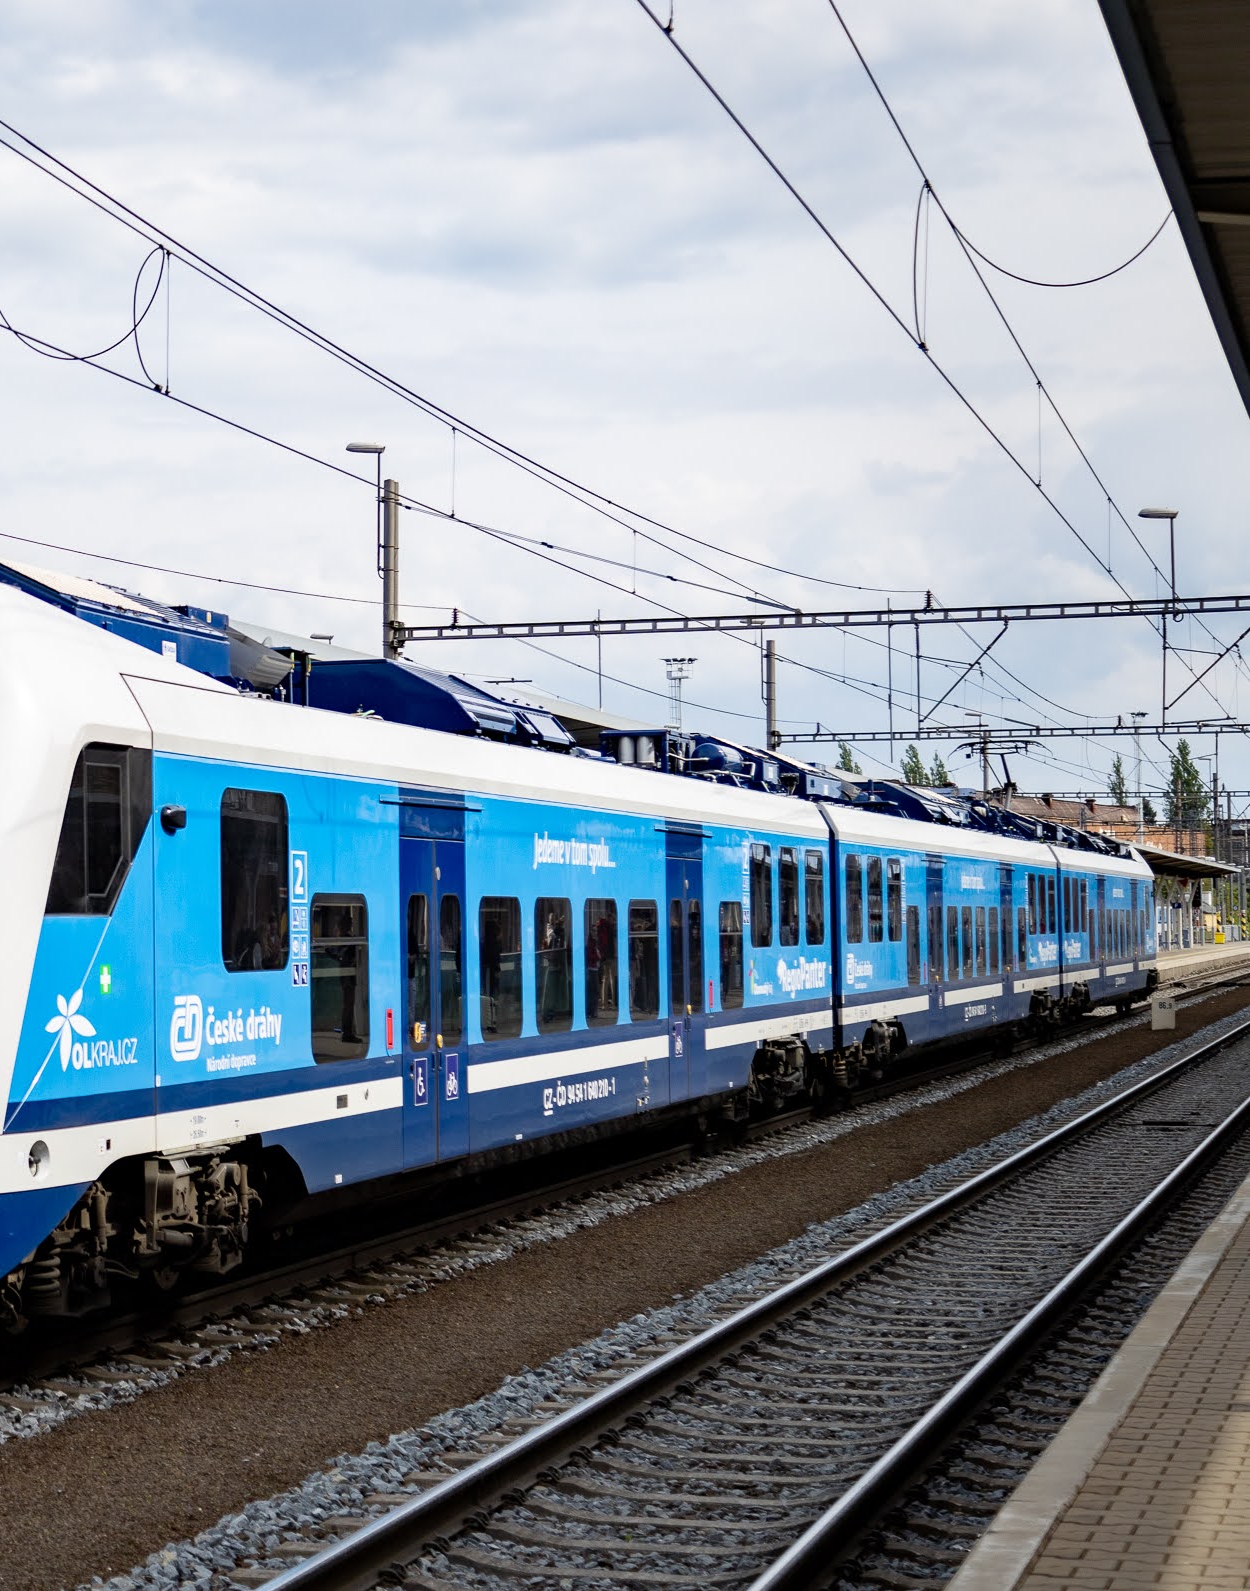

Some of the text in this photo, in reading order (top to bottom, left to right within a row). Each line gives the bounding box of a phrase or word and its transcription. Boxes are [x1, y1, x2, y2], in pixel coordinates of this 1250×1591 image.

[532, 830, 565, 871] Jedeme
[565, 841, 571, 865] v
[571, 837, 588, 866] tom
[293, 858, 305, 895] 2
[206, 1005, 244, 1046] České
[246, 1005, 282, 1046] dráhy
[206, 1053, 257, 1073] Národní dopravce
